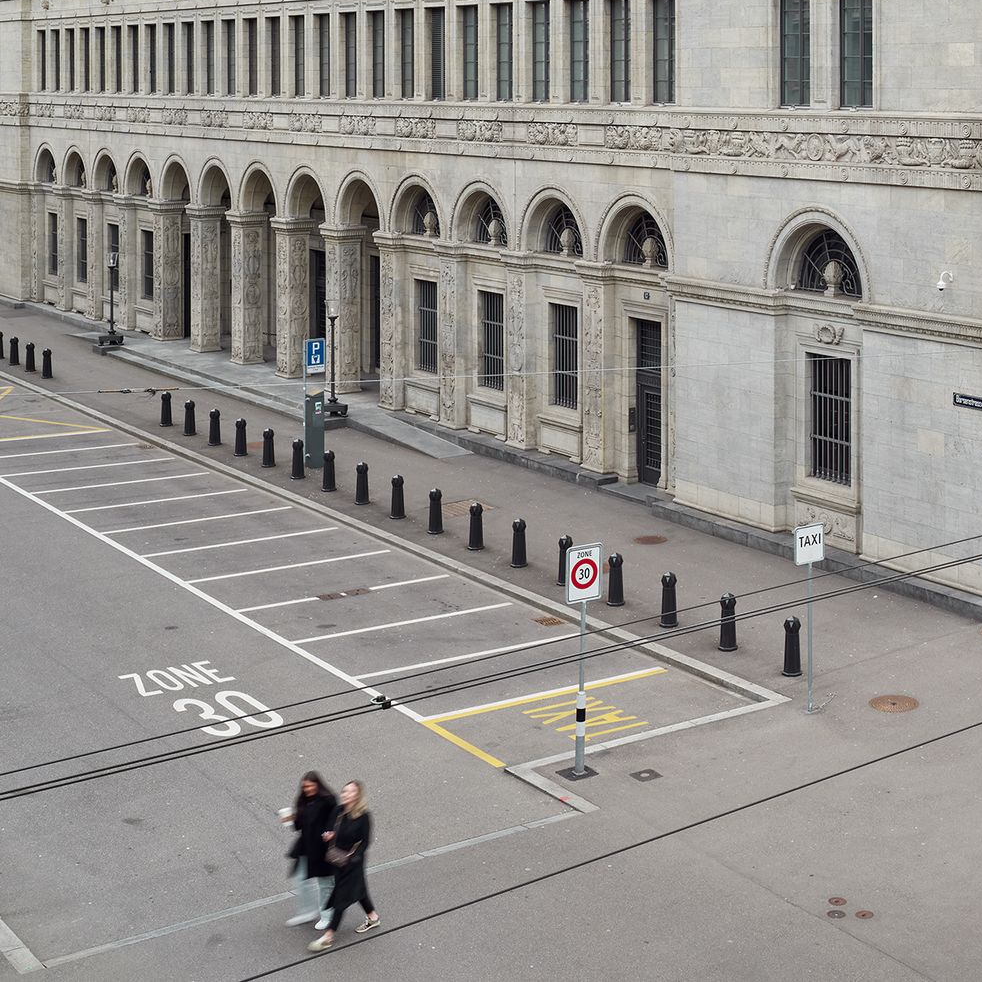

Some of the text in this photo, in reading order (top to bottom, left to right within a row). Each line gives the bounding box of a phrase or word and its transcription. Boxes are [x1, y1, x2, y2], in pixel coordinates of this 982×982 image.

[312, 342, 320, 354] P
[799, 533, 821, 548] TAXI
[577, 549, 593, 559] ZONE
[578, 567, 590, 580] 30
[118, 660, 237, 697] ZONE
[172, 690, 284, 737] 30
